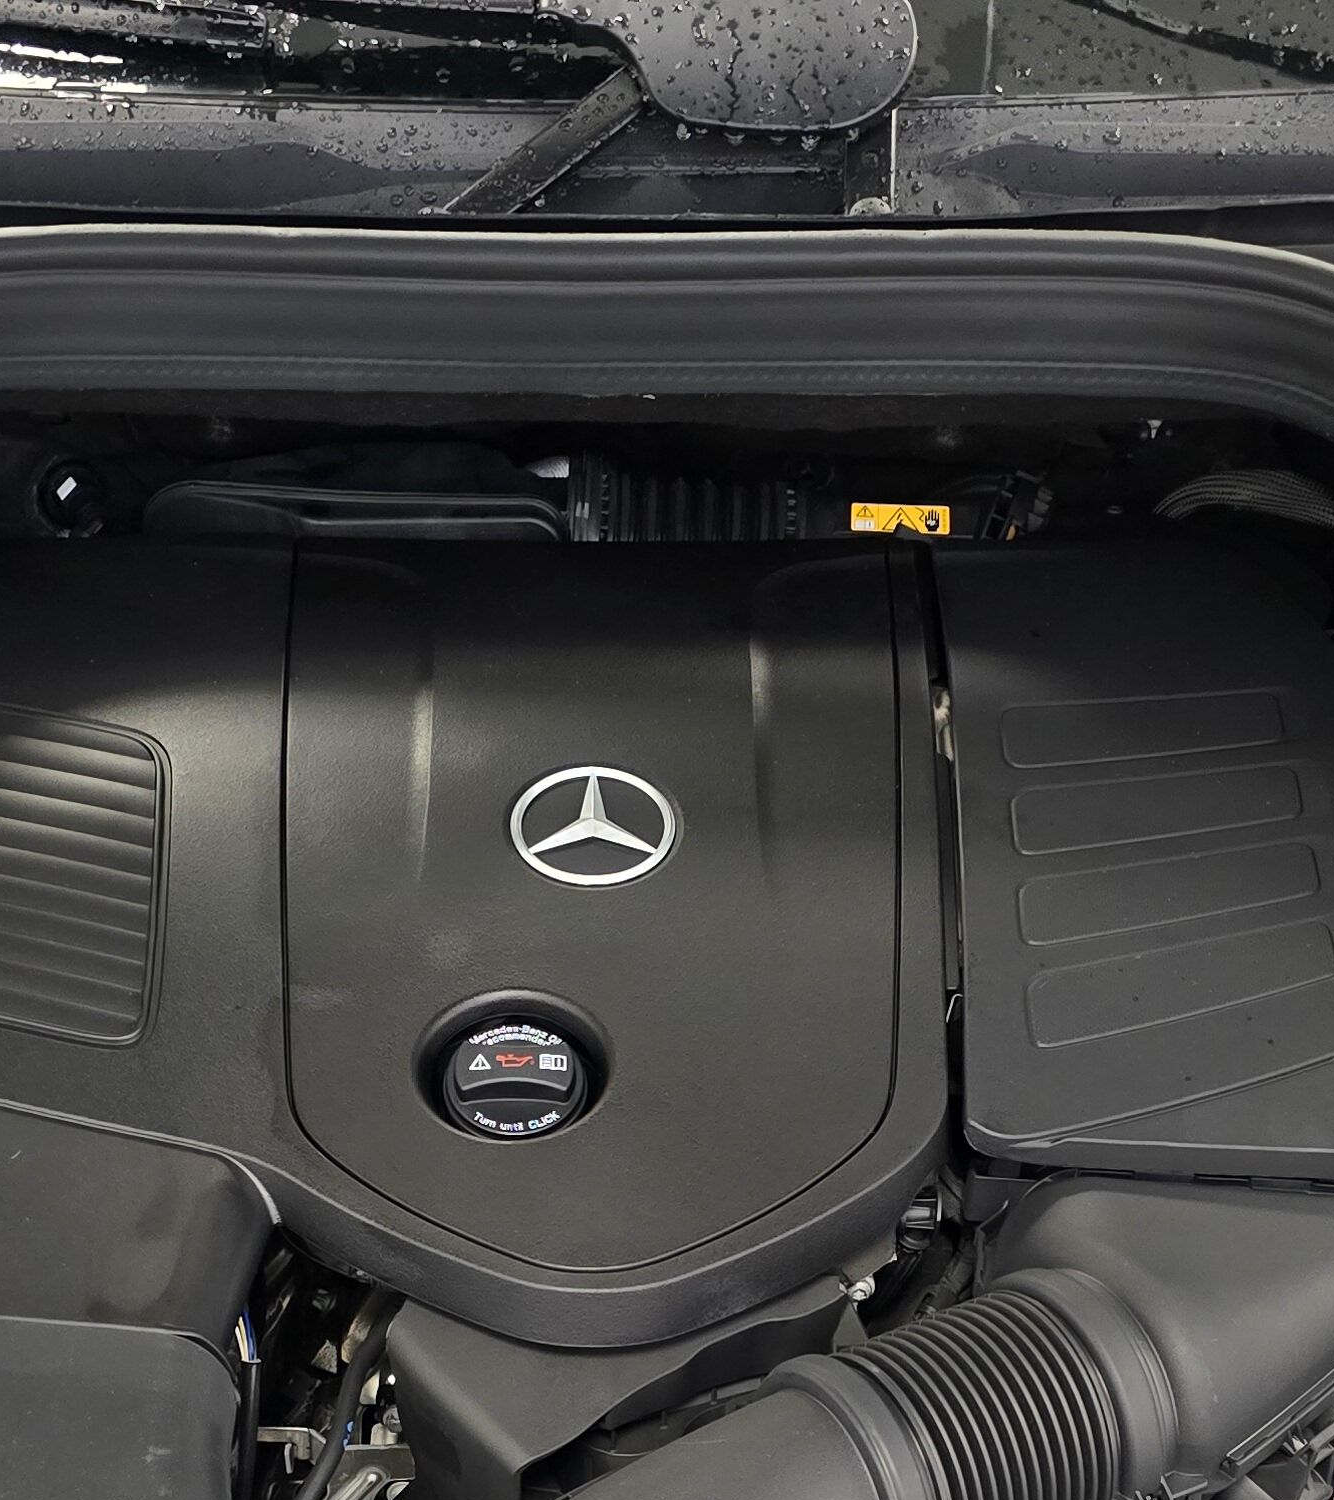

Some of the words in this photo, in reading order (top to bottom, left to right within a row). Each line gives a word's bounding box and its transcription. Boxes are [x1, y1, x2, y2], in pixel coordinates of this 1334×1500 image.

[473, 1111, 496, 1128] Turn
[500, 1121, 524, 1132] until
[528, 1111, 561, 1130] CLICK
